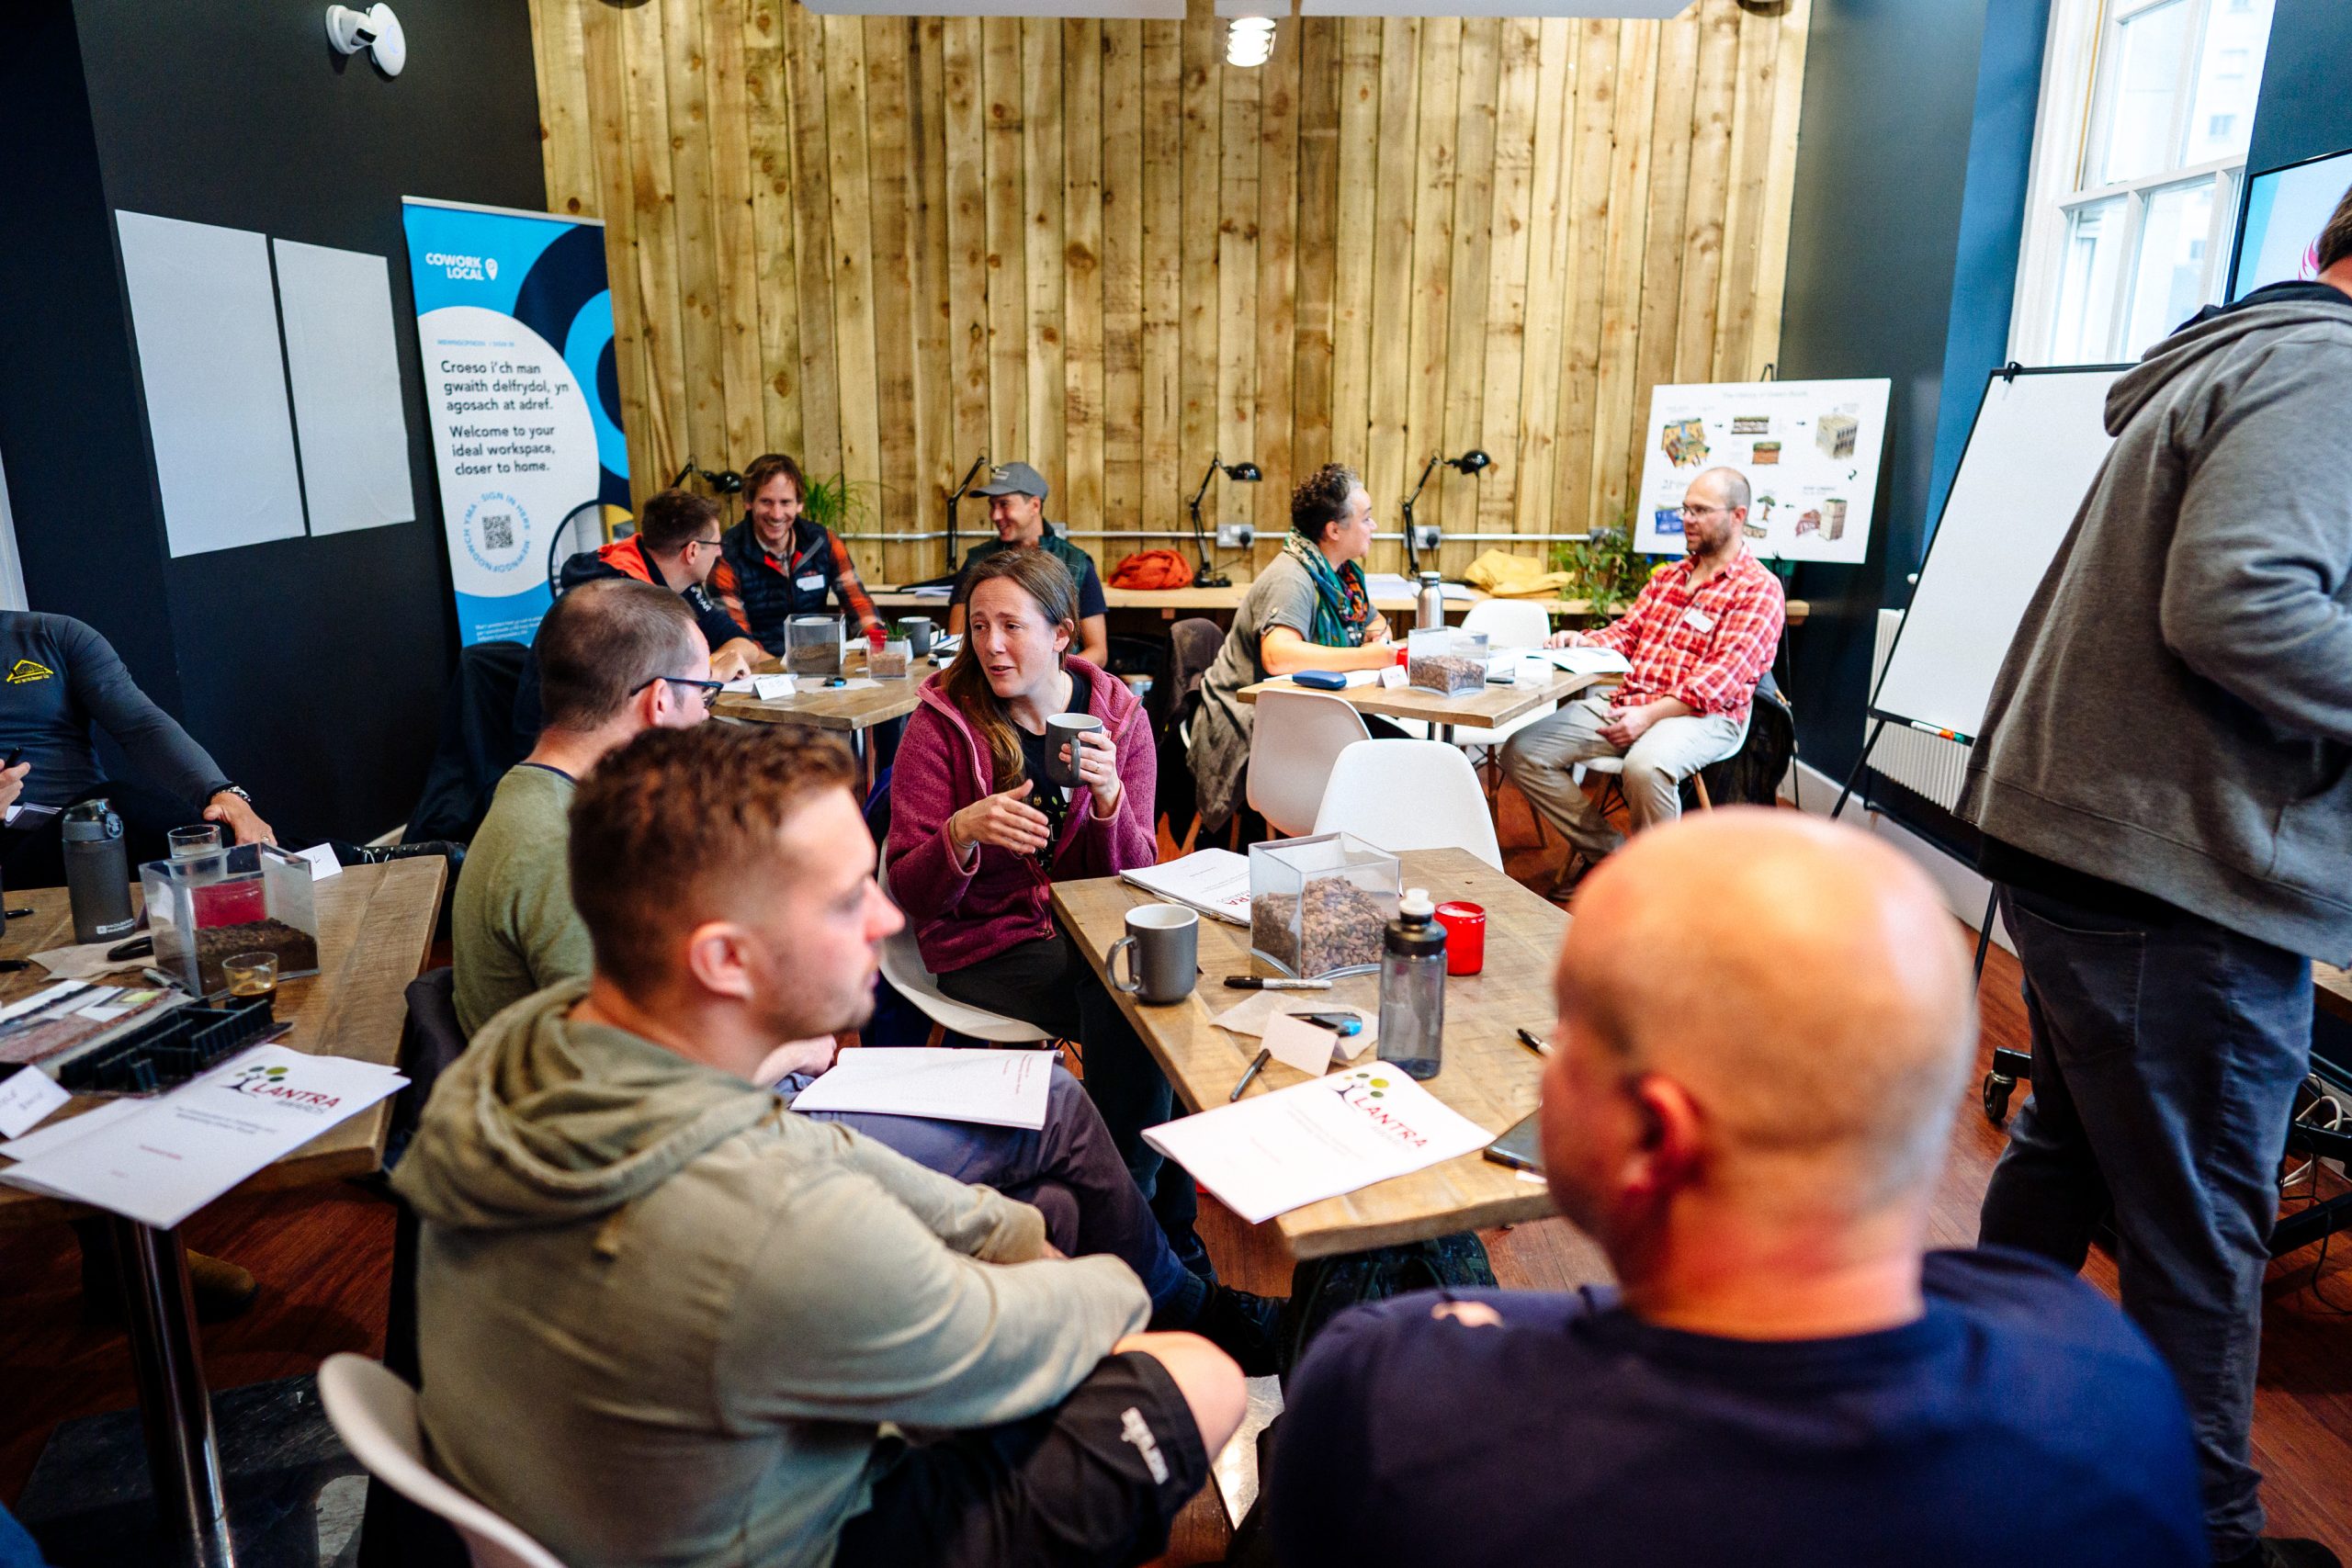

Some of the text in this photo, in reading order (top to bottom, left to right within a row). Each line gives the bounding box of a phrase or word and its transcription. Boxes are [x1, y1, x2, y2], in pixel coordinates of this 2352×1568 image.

[426, 253, 482, 268] COWORK
[447, 266, 485, 280] LOCAL
[441, 360, 487, 374] Croeso
[517, 366, 540, 374] man
[444, 379, 569, 398] gwaith delfrydol, yn
[447, 398, 548, 414] agosach at adref.
[449, 425, 554, 439] Welcome to your
[452, 443, 554, 457] ideal workspace,
[455, 461, 549, 475] closer to home.
[481, 491, 503, 501] SIGN
[516, 502, 530, 530] HERE
[252, 1082, 342, 1109] LANTRA
[1352, 1096, 1429, 1147] LANTRA
